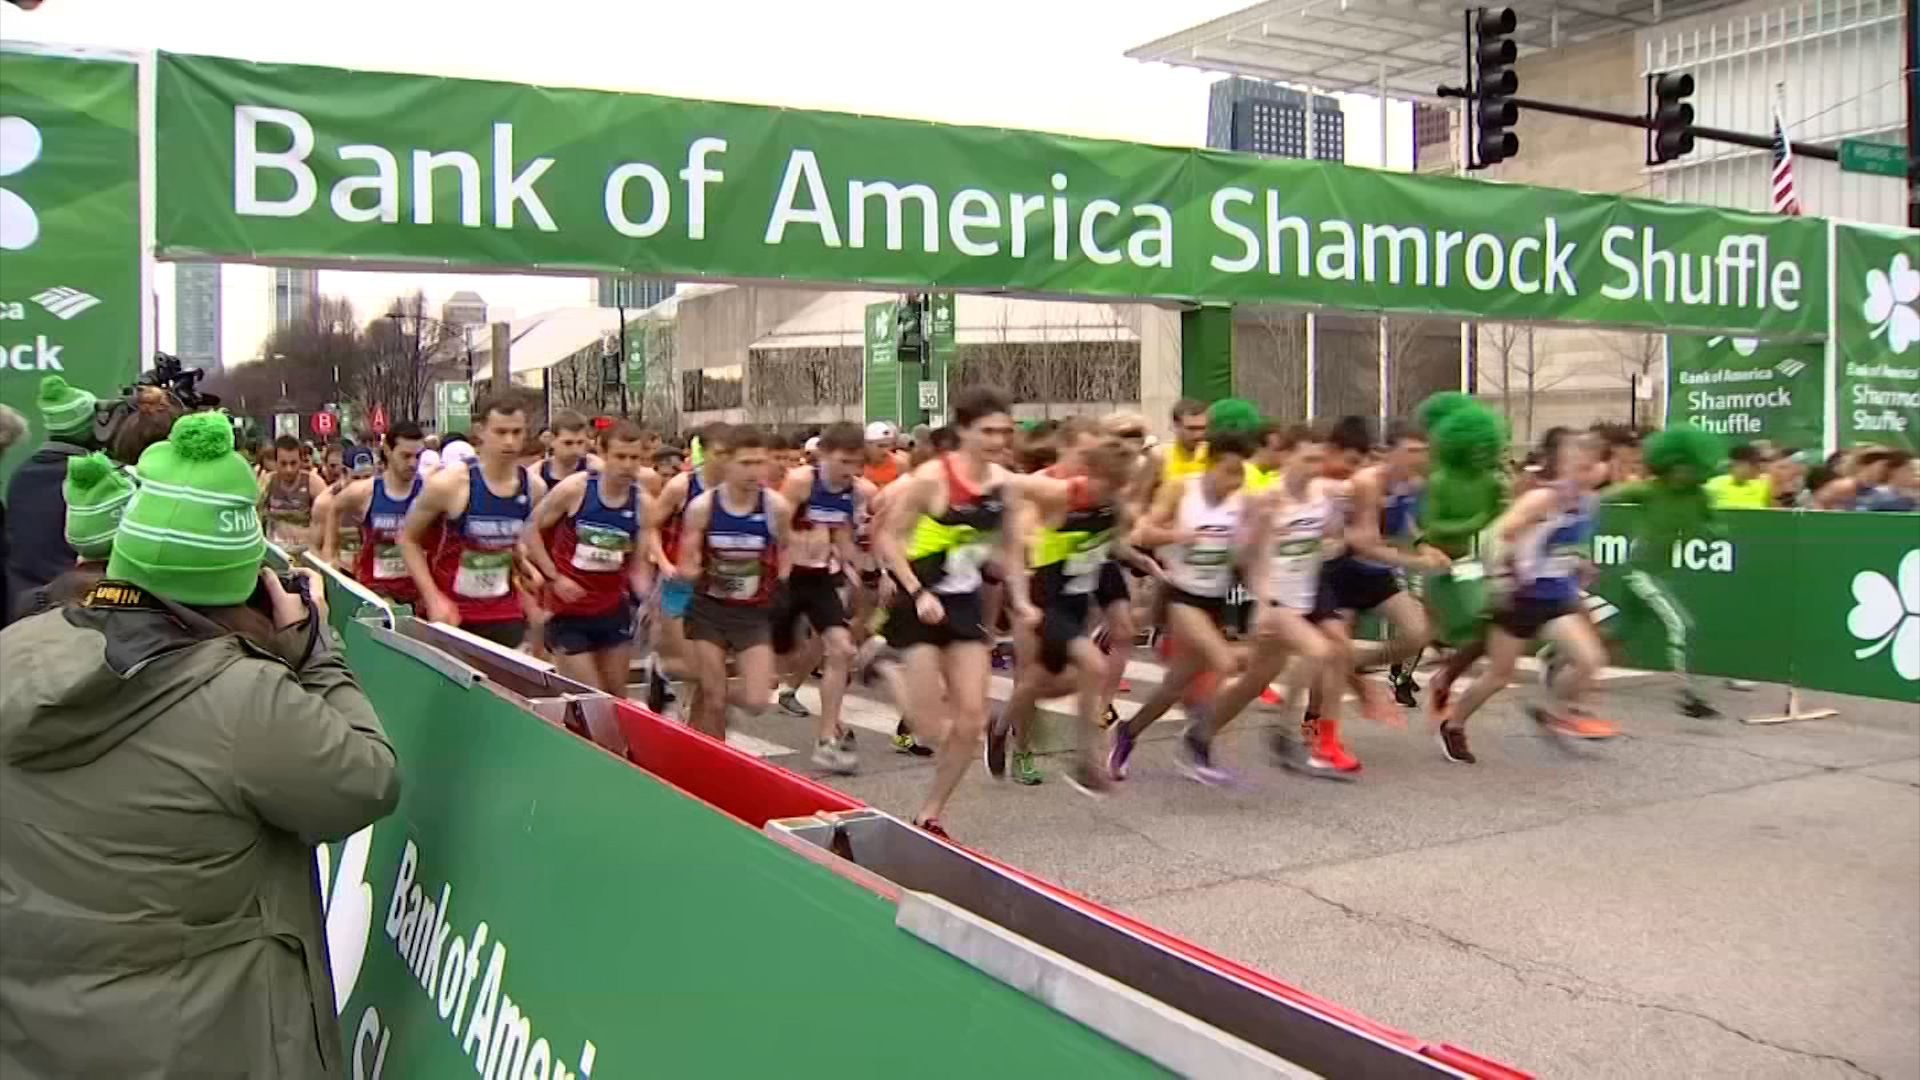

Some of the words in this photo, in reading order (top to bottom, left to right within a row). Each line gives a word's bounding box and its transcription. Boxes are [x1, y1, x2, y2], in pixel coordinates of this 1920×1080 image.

[233, 104, 558, 232] Bank
[604, 137, 727, 241] of
[764, 148, 1173, 268] America
[1210, 186, 1578, 297] Shamrock
[1599, 225, 1802, 311] Shuffle
[1679, 371, 1710, 384] Bank
[1723, 368, 1773, 382] America
[1687, 385, 1793, 411] Shamrock
[319, 414, 332, 428] B
[373, 407, 385, 427] A
[1688, 413, 1762, 434] Shuffle
[1853, 409, 1908, 432] Shuffle
[384, 838, 451, 1001] Bank
[437, 920, 489, 1038] of
